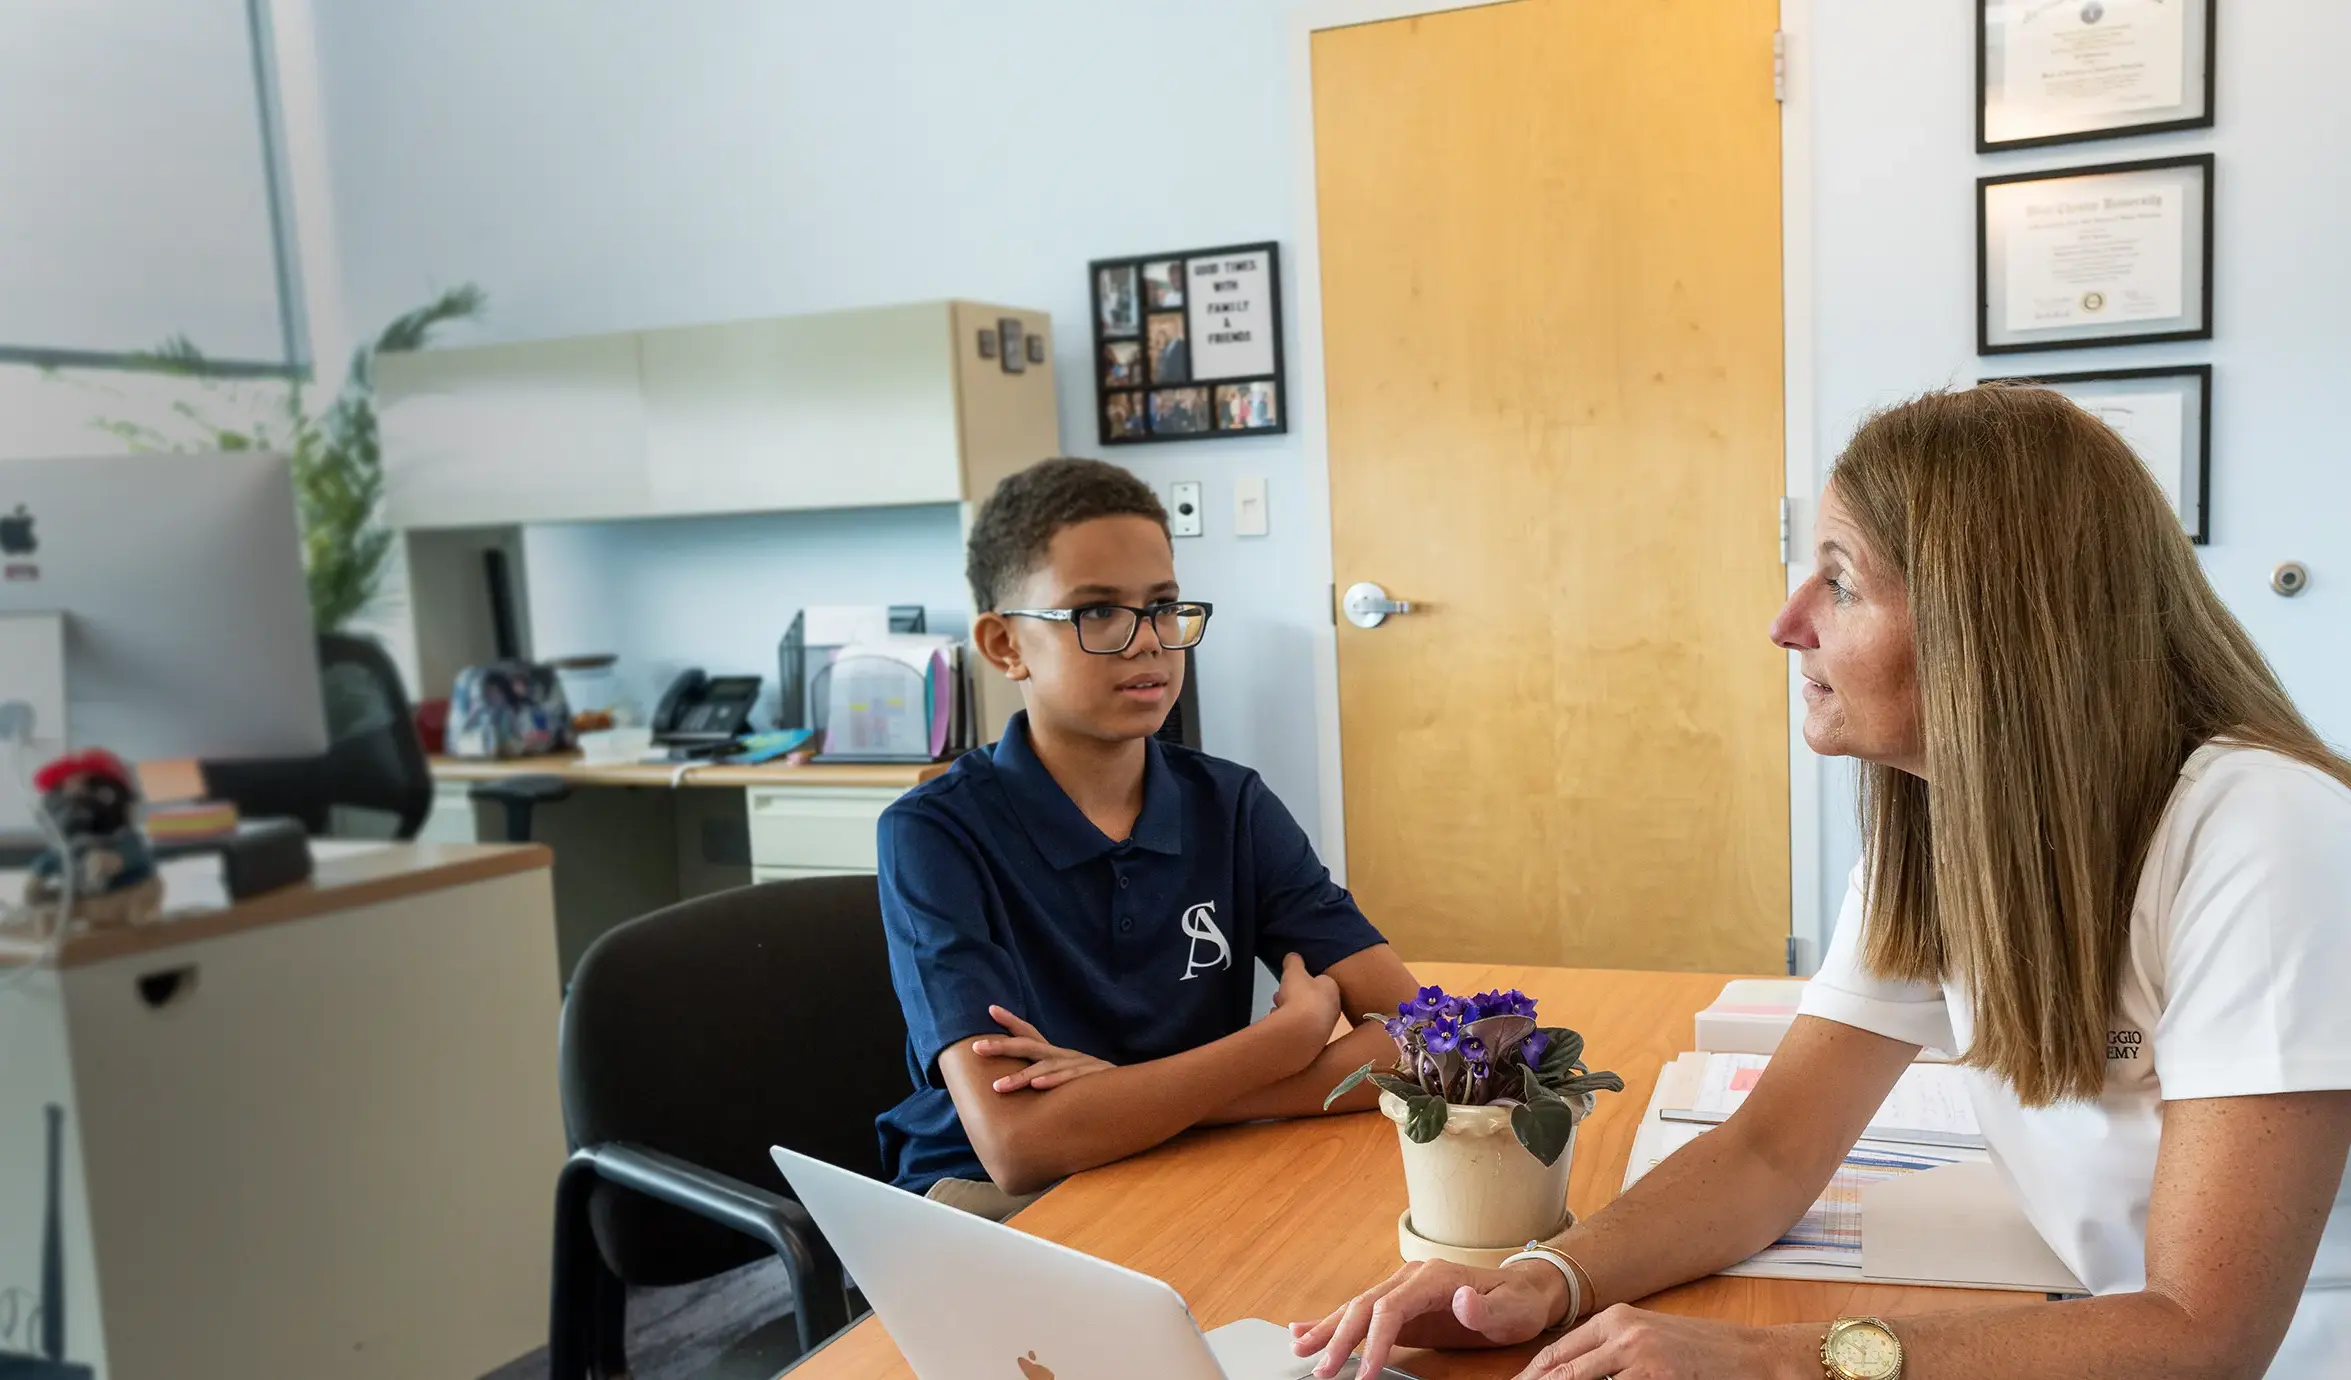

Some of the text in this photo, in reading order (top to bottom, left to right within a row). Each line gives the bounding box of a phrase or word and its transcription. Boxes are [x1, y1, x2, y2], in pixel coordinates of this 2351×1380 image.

[1195, 260, 1257, 275] GOOD TIMES
[1213, 280, 1238, 292] WITH
[1207, 300, 1249, 314] FAMILY
[1208, 331, 1251, 344] FRIENDS
